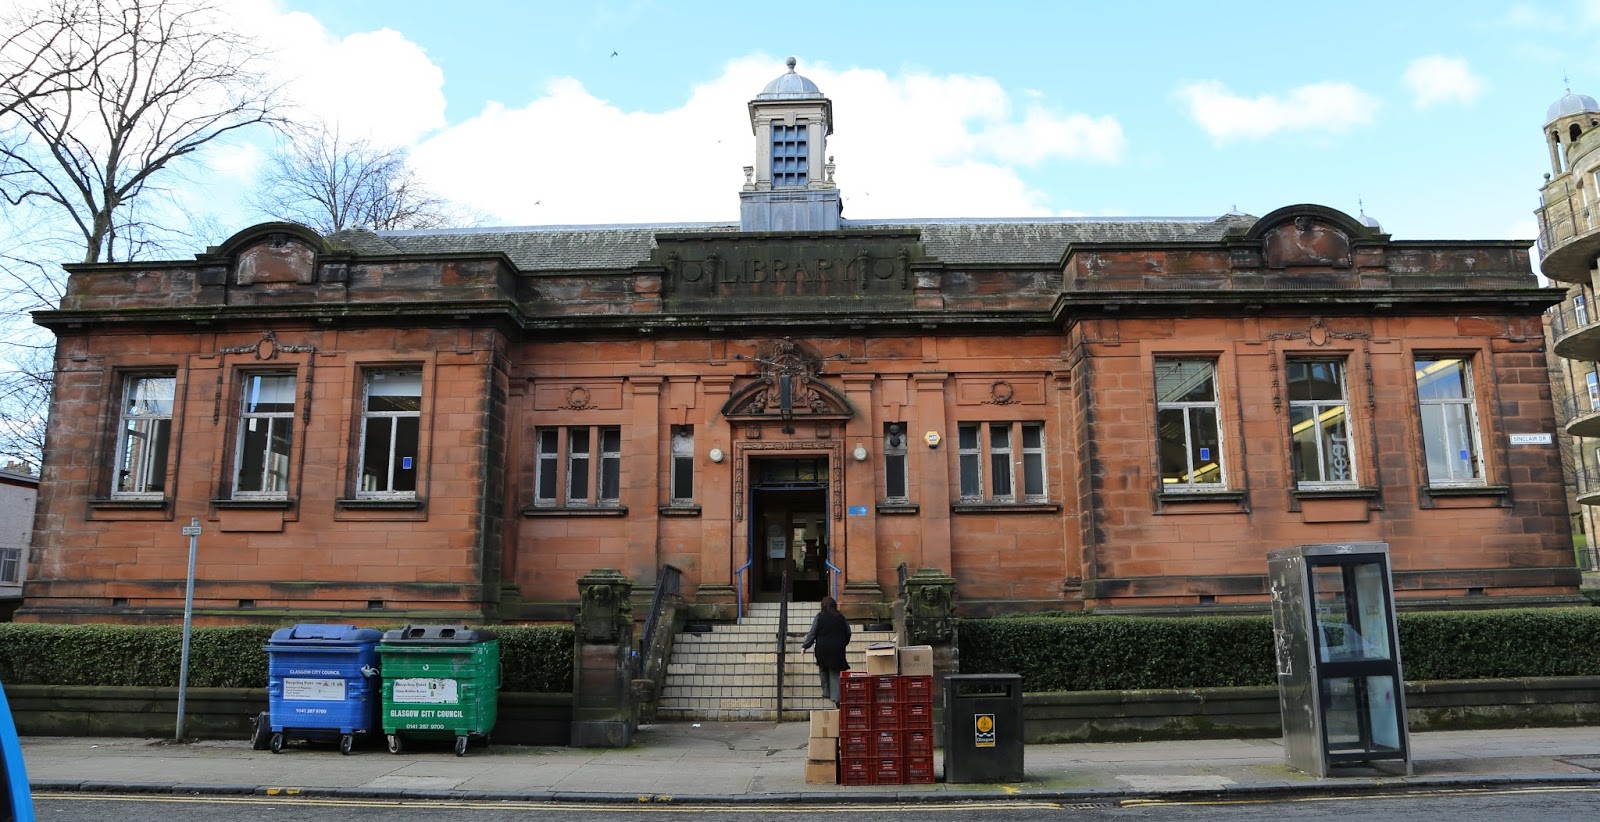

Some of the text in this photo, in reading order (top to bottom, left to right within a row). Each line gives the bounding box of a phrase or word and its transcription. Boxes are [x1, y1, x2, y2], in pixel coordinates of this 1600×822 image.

[719, 258, 859, 284] LIBRARY
[390, 709, 463, 718] GLASGOW CITY COUNCIL
